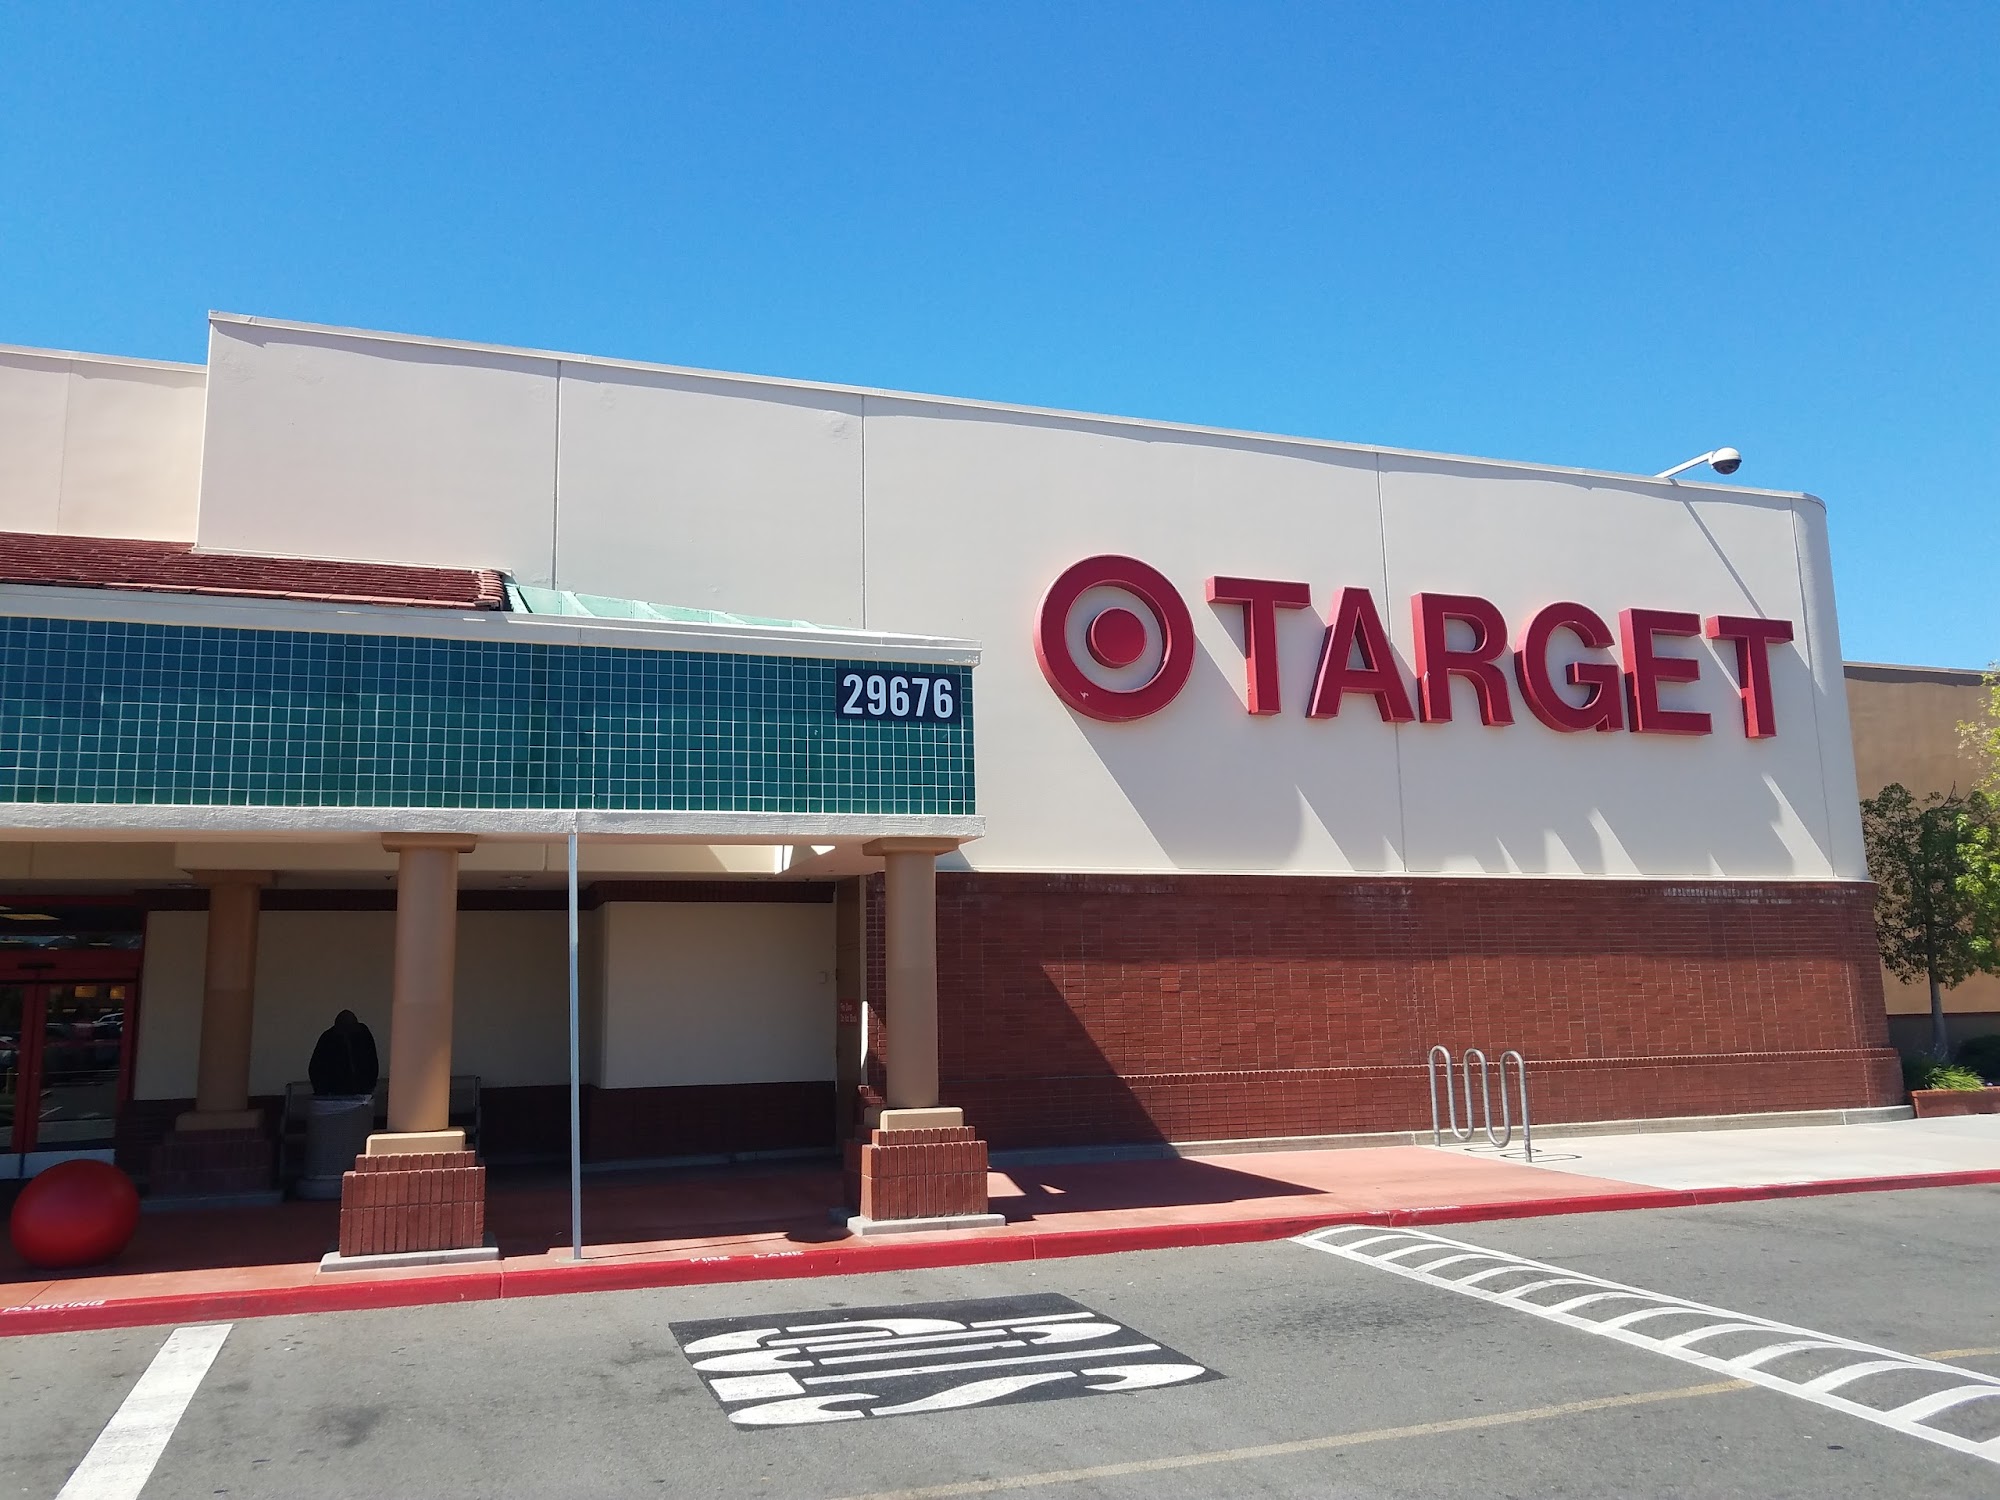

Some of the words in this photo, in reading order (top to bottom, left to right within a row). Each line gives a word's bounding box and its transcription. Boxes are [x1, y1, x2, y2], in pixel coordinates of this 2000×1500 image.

[1206, 575, 1795, 739] TARGET
[842, 673, 954, 719] 29676
[753, 1250, 804, 1259] LANE
[1, 1300, 106, 1313] PARKING
[684, 1311, 1206, 1426] STOP
